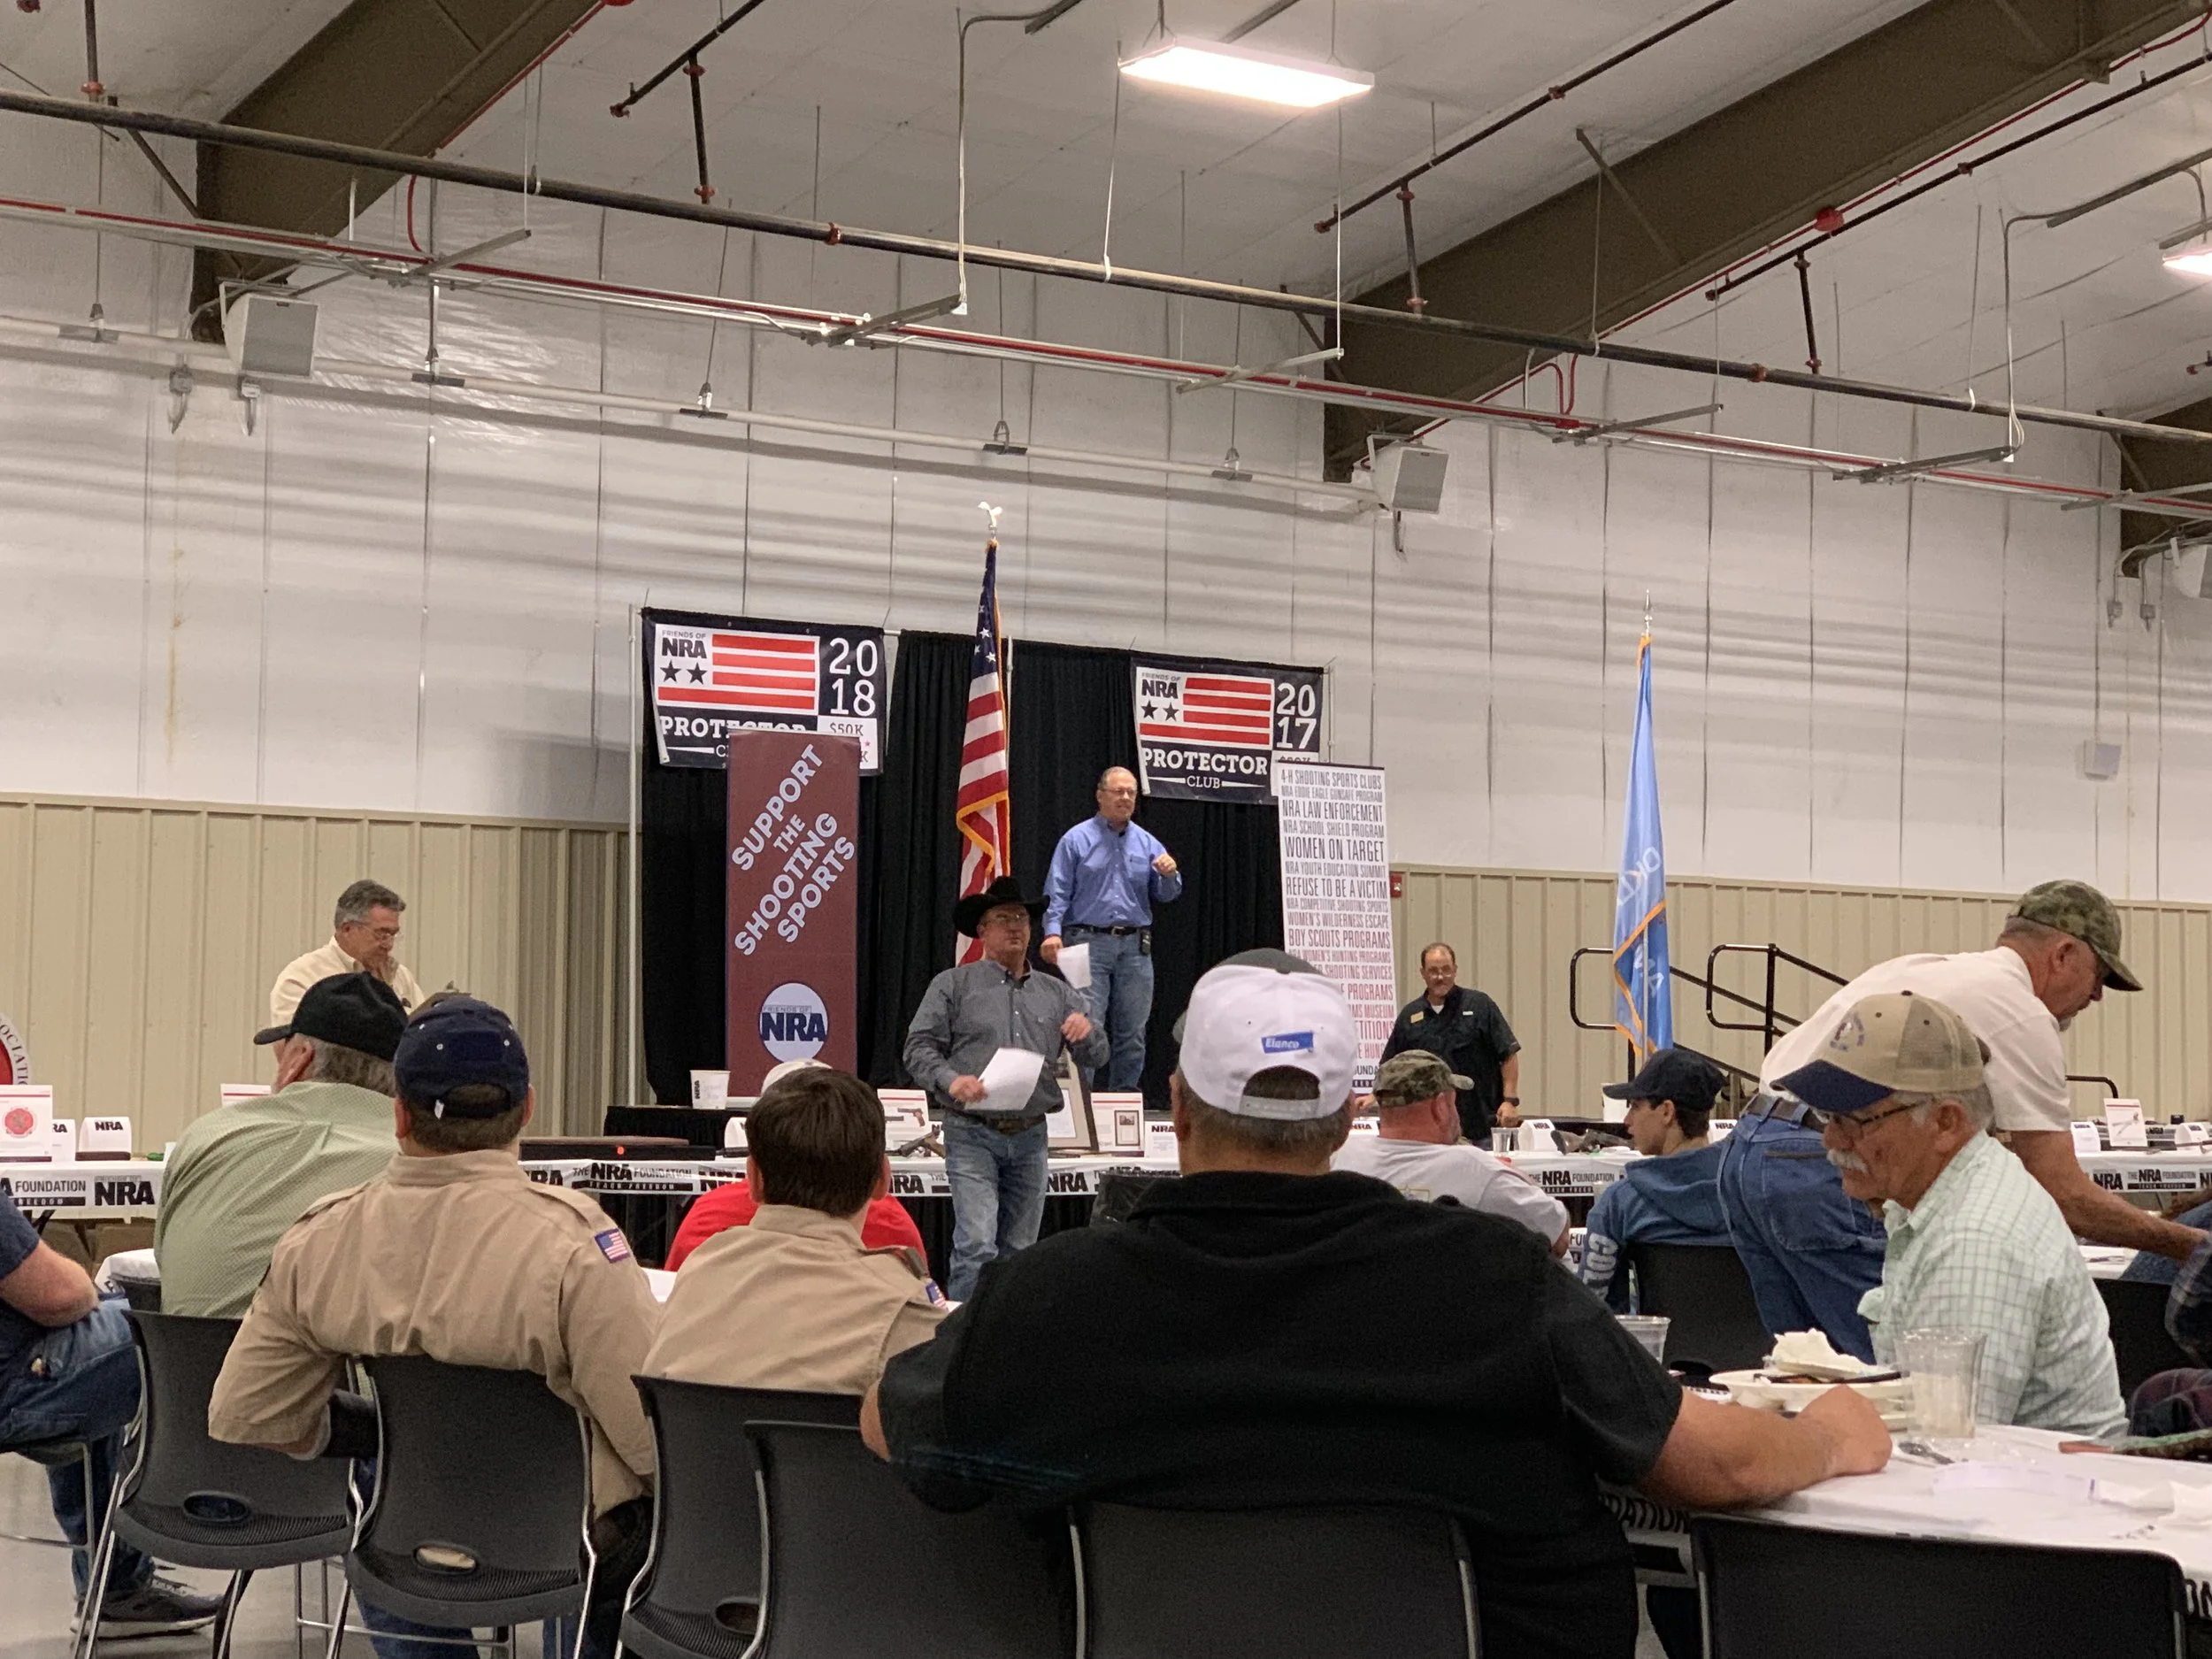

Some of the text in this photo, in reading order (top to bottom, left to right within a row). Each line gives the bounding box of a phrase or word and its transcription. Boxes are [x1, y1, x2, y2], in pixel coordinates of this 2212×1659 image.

[662, 638, 707, 658] NRA
[829, 637, 878, 677] 20
[830, 679, 876, 717] 18
[1141, 680, 1179, 699] NRA
[1276, 682, 1316, 717] 20
[1276, 717, 1317, 749] 17
[1142, 748, 1268, 776] PROTECTOR
[1187, 775, 1220, 788] CLUB
[1281, 770, 1381, 789] 4-H SHOOTING SPORTS CLUBS
[732, 744, 823, 871] SUPPORT
[1282, 800, 1382, 822] NRA LAW ENFORCEMENT
[773, 814, 805, 853] THE
[1283, 819, 1384, 838] NRA SCHOOL SHIELD PROGRAM
[1285, 836, 1384, 862] WOMEN ON TARGET
[1285, 861, 1386, 878] NRA YOUTH EDUCATION SUMMIT
[734, 813, 837, 956] SHOOTING
[777, 837, 854, 942] SPORTS
[1286, 877, 1387, 899] REFUSE TO BE A VICTIM
[1287, 911, 1389, 929] WOMEN'S WILDERNESS ESCAPE
[1288, 929, 1391, 949] BOY SCOUTS PROGRAMS
[1333, 950, 1357, 963] HUNTING
[1325, 964, 1360, 979] SHOOTING
[1363, 965, 1393, 980] SERVICES
[1348, 984, 1393, 1000] PROGRAMS
[1364, 1004, 1394, 1018] MUSEUM
[762, 1013, 826, 1041] NRA
[52, 1124, 67, 1133] RA
[95, 1121, 123, 1131] NRA
[591, 1163, 632, 1180] NRA
[1542, 1171, 1571, 1185] NRA
[1572, 1173, 1615, 1182] FOUNDATION
[2139, 1169, 2162, 1182] NRA
[16, 1180, 86, 1193] FOUNDATION
[95, 1181, 156, 1206] NRA
